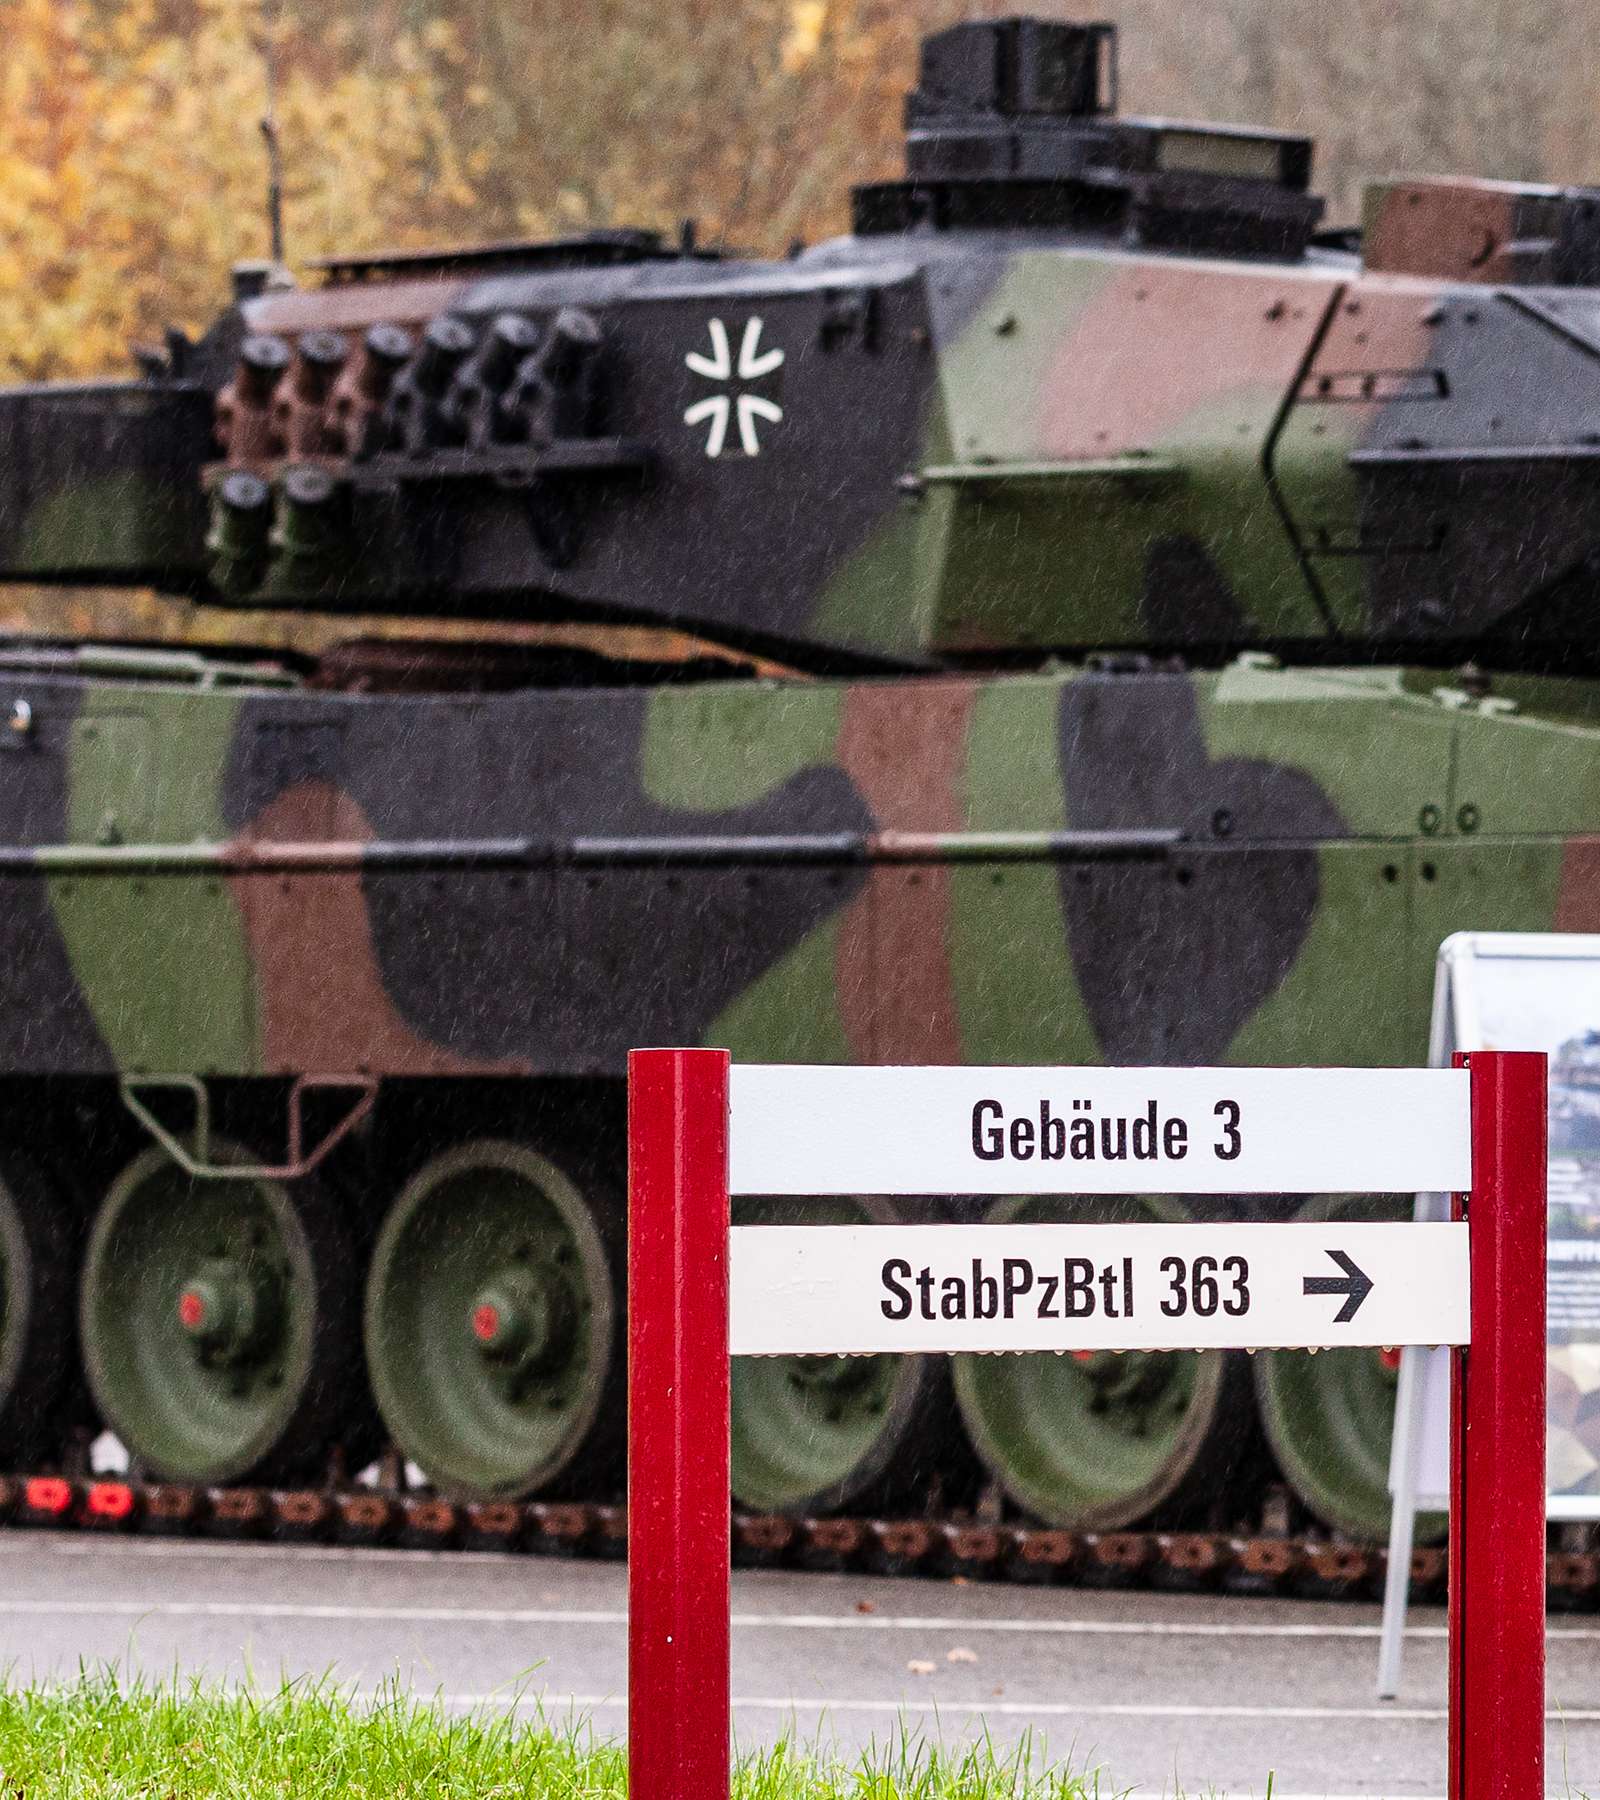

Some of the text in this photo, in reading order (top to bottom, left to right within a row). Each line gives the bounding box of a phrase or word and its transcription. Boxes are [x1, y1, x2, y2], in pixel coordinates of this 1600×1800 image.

[971, 1099, 1242, 1161] Gebäude 3
[880, 1255, 1251, 1320] StabPzBtl 363
